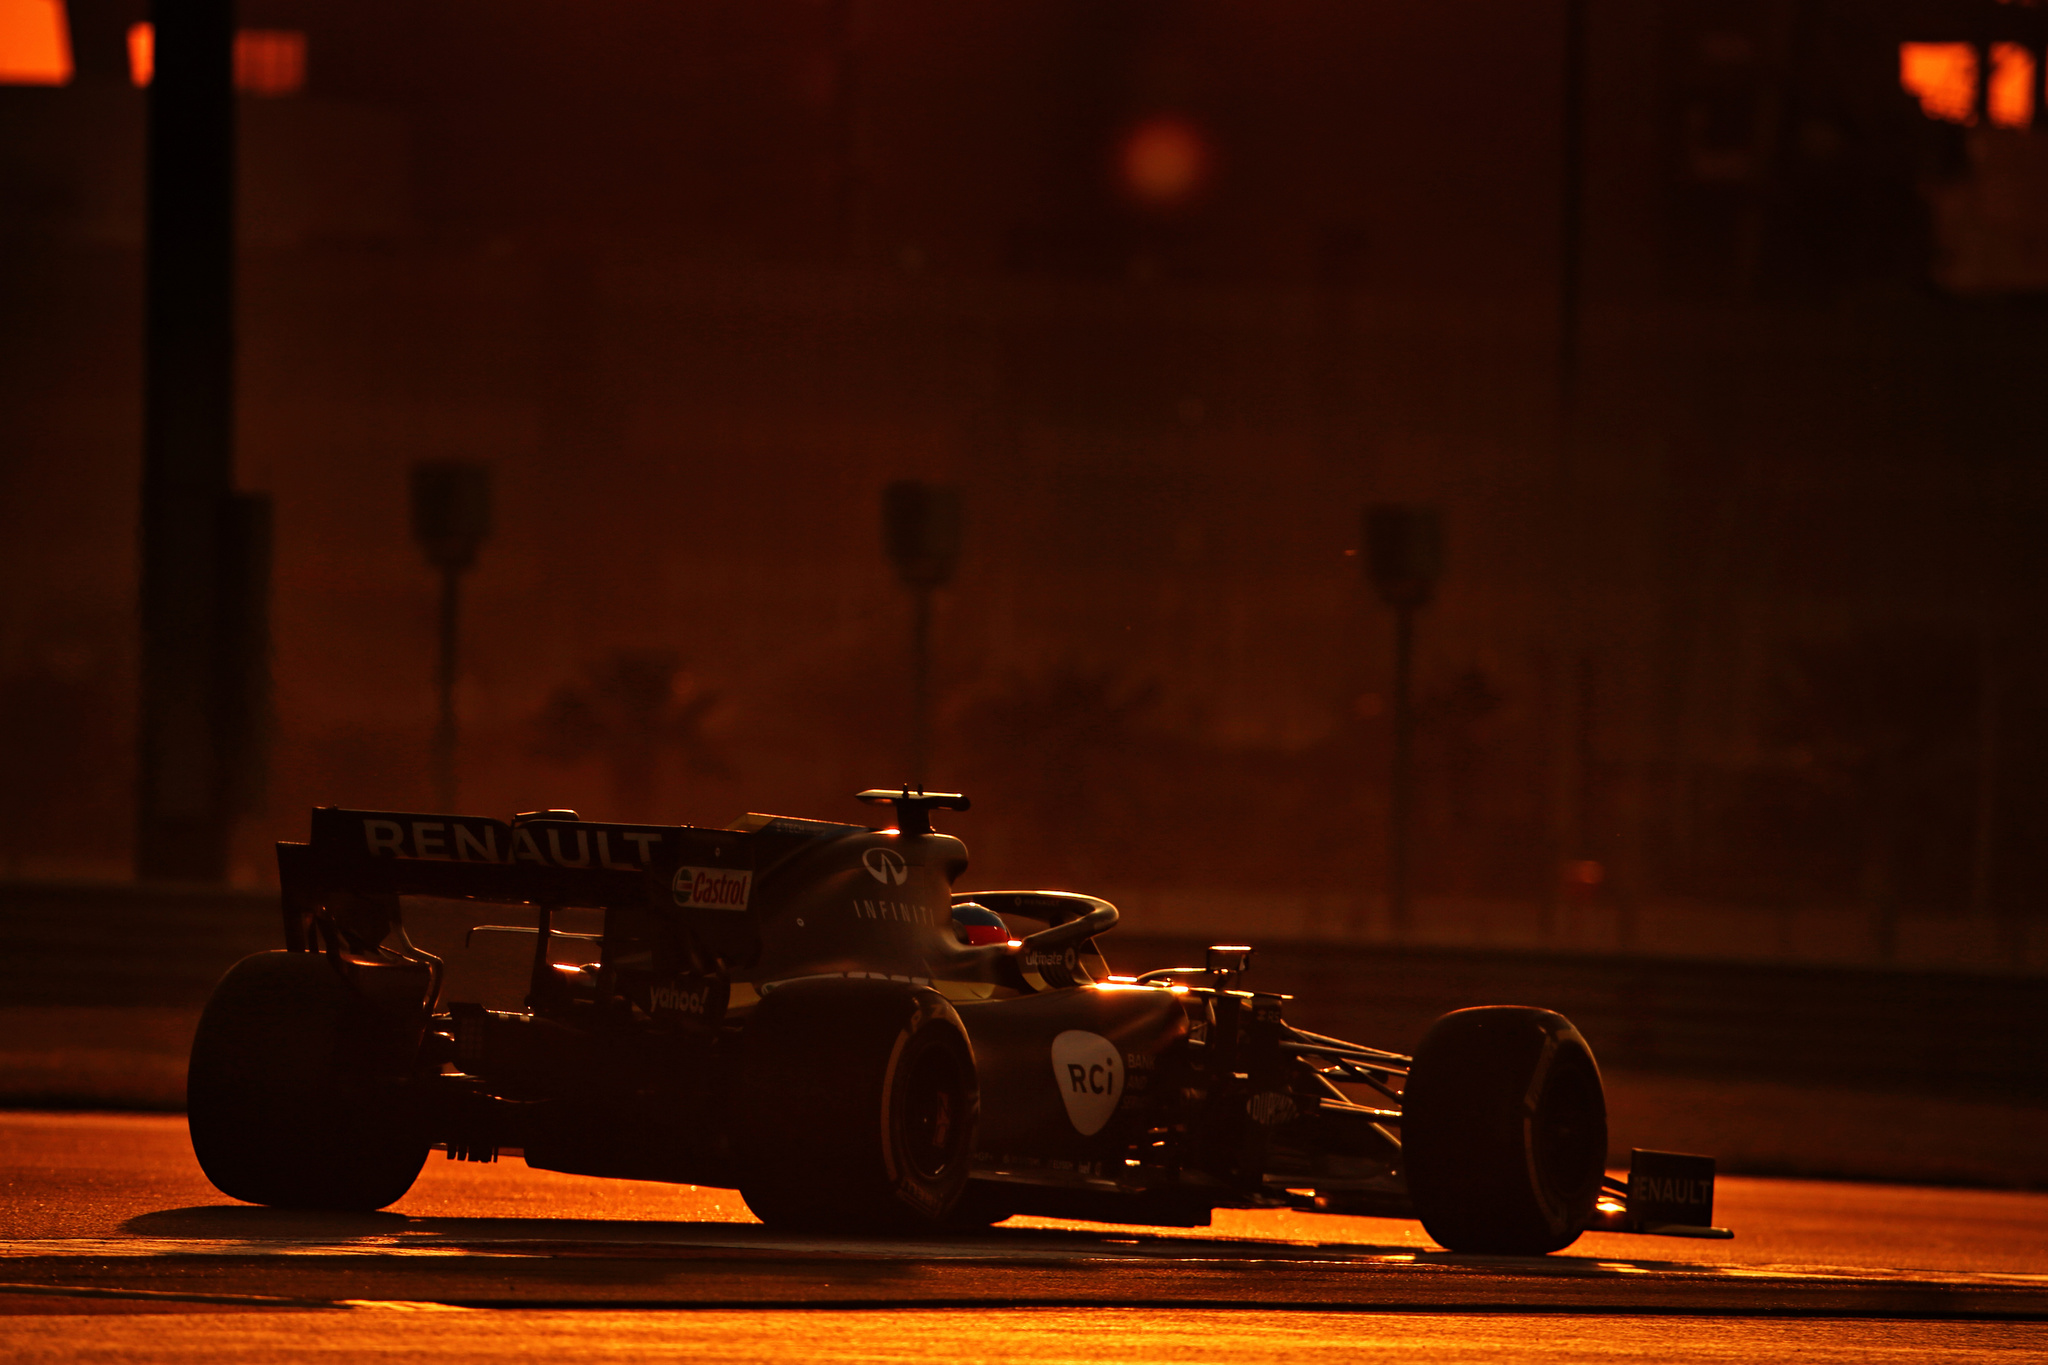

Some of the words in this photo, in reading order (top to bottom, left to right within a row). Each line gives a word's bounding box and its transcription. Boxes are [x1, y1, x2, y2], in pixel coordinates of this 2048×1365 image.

[362, 818, 662, 870] RENAULT
[693, 872, 748, 905] Castrol
[853, 900, 935, 927] INFINITI
[1025, 949, 1063, 966] ultimate
[649, 981, 710, 1015] yahoo!
[1067, 1057, 1113, 1096] RCi
[1127, 1053, 1157, 1070] BANK
